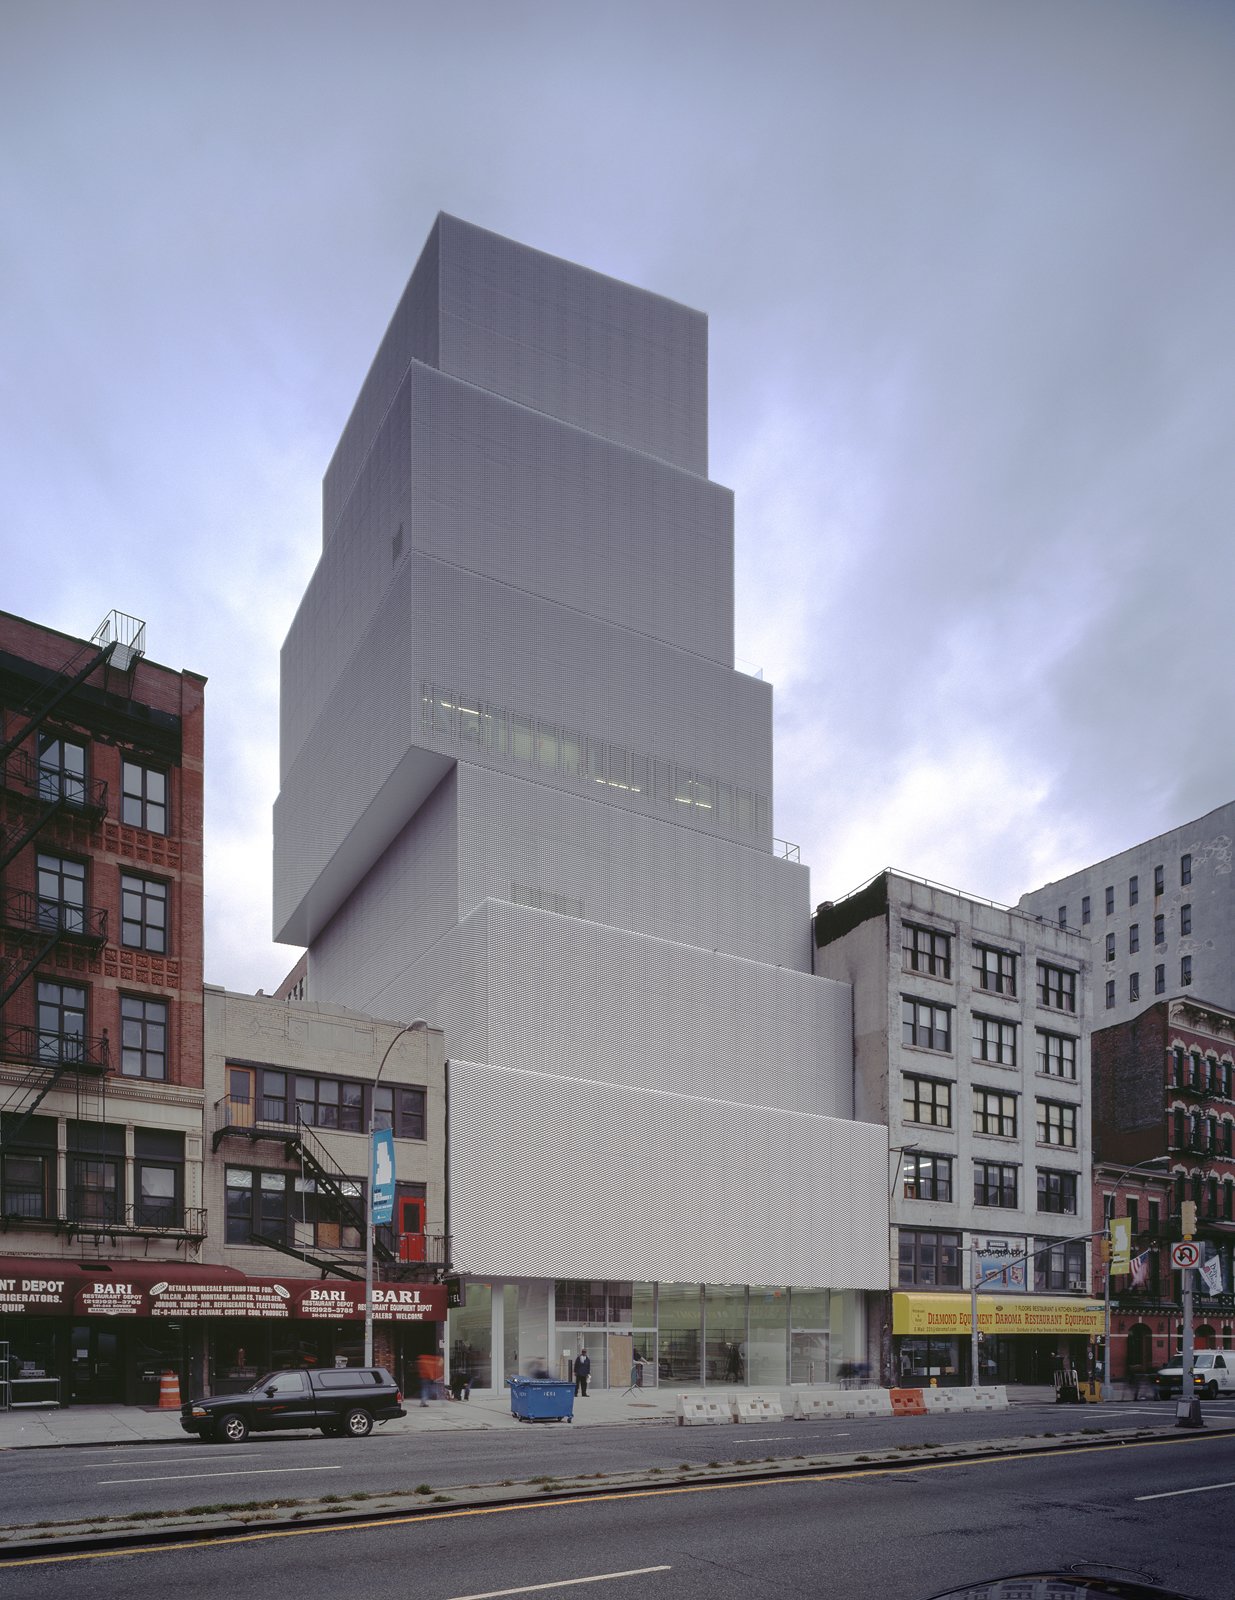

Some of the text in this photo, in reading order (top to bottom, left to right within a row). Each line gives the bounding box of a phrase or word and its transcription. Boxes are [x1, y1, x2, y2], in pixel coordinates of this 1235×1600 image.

[22, 1280, 64, 1292] DEPOT
[93, 1283, 132, 1294] BARI
[310, 1289, 346, 1301] BARI
[371, 1289, 420, 1303] BARI
[0, 1303, 25, 1312] QUIP.
[357, 1303, 389, 1311] RESURANT
[417, 1304, 433, 1312] DEPOT
[1032, 1305, 1054, 1313] RESTAURANT
[371, 1312, 393, 1320] EALERS
[927, 1312, 957, 1325] DIAMOND
[959, 1312, 993, 1326] EQUMENT
[995, 1312, 1022, 1325] DAROMA
[1024, 1313, 1062, 1325] RESTAURANT
[1064, 1313, 1098, 1326] EQUIPMENT
